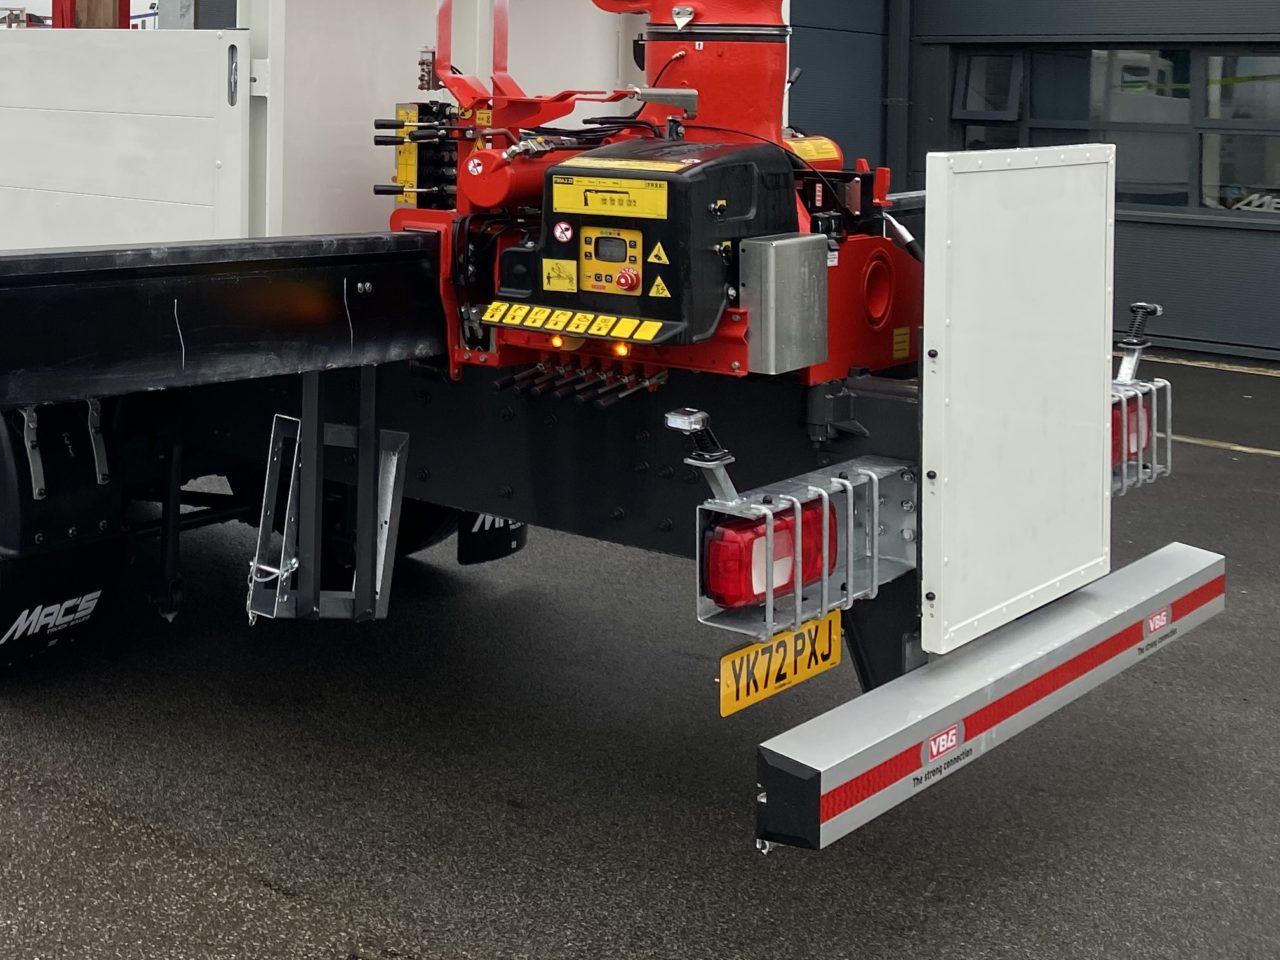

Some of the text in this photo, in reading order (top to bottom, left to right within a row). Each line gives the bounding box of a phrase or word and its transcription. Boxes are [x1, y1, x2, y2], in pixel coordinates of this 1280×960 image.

[1148, 611, 1167, 632] VBG
[930, 728, 957, 757] VBG
[912, 747, 973, 788] The strong connection
